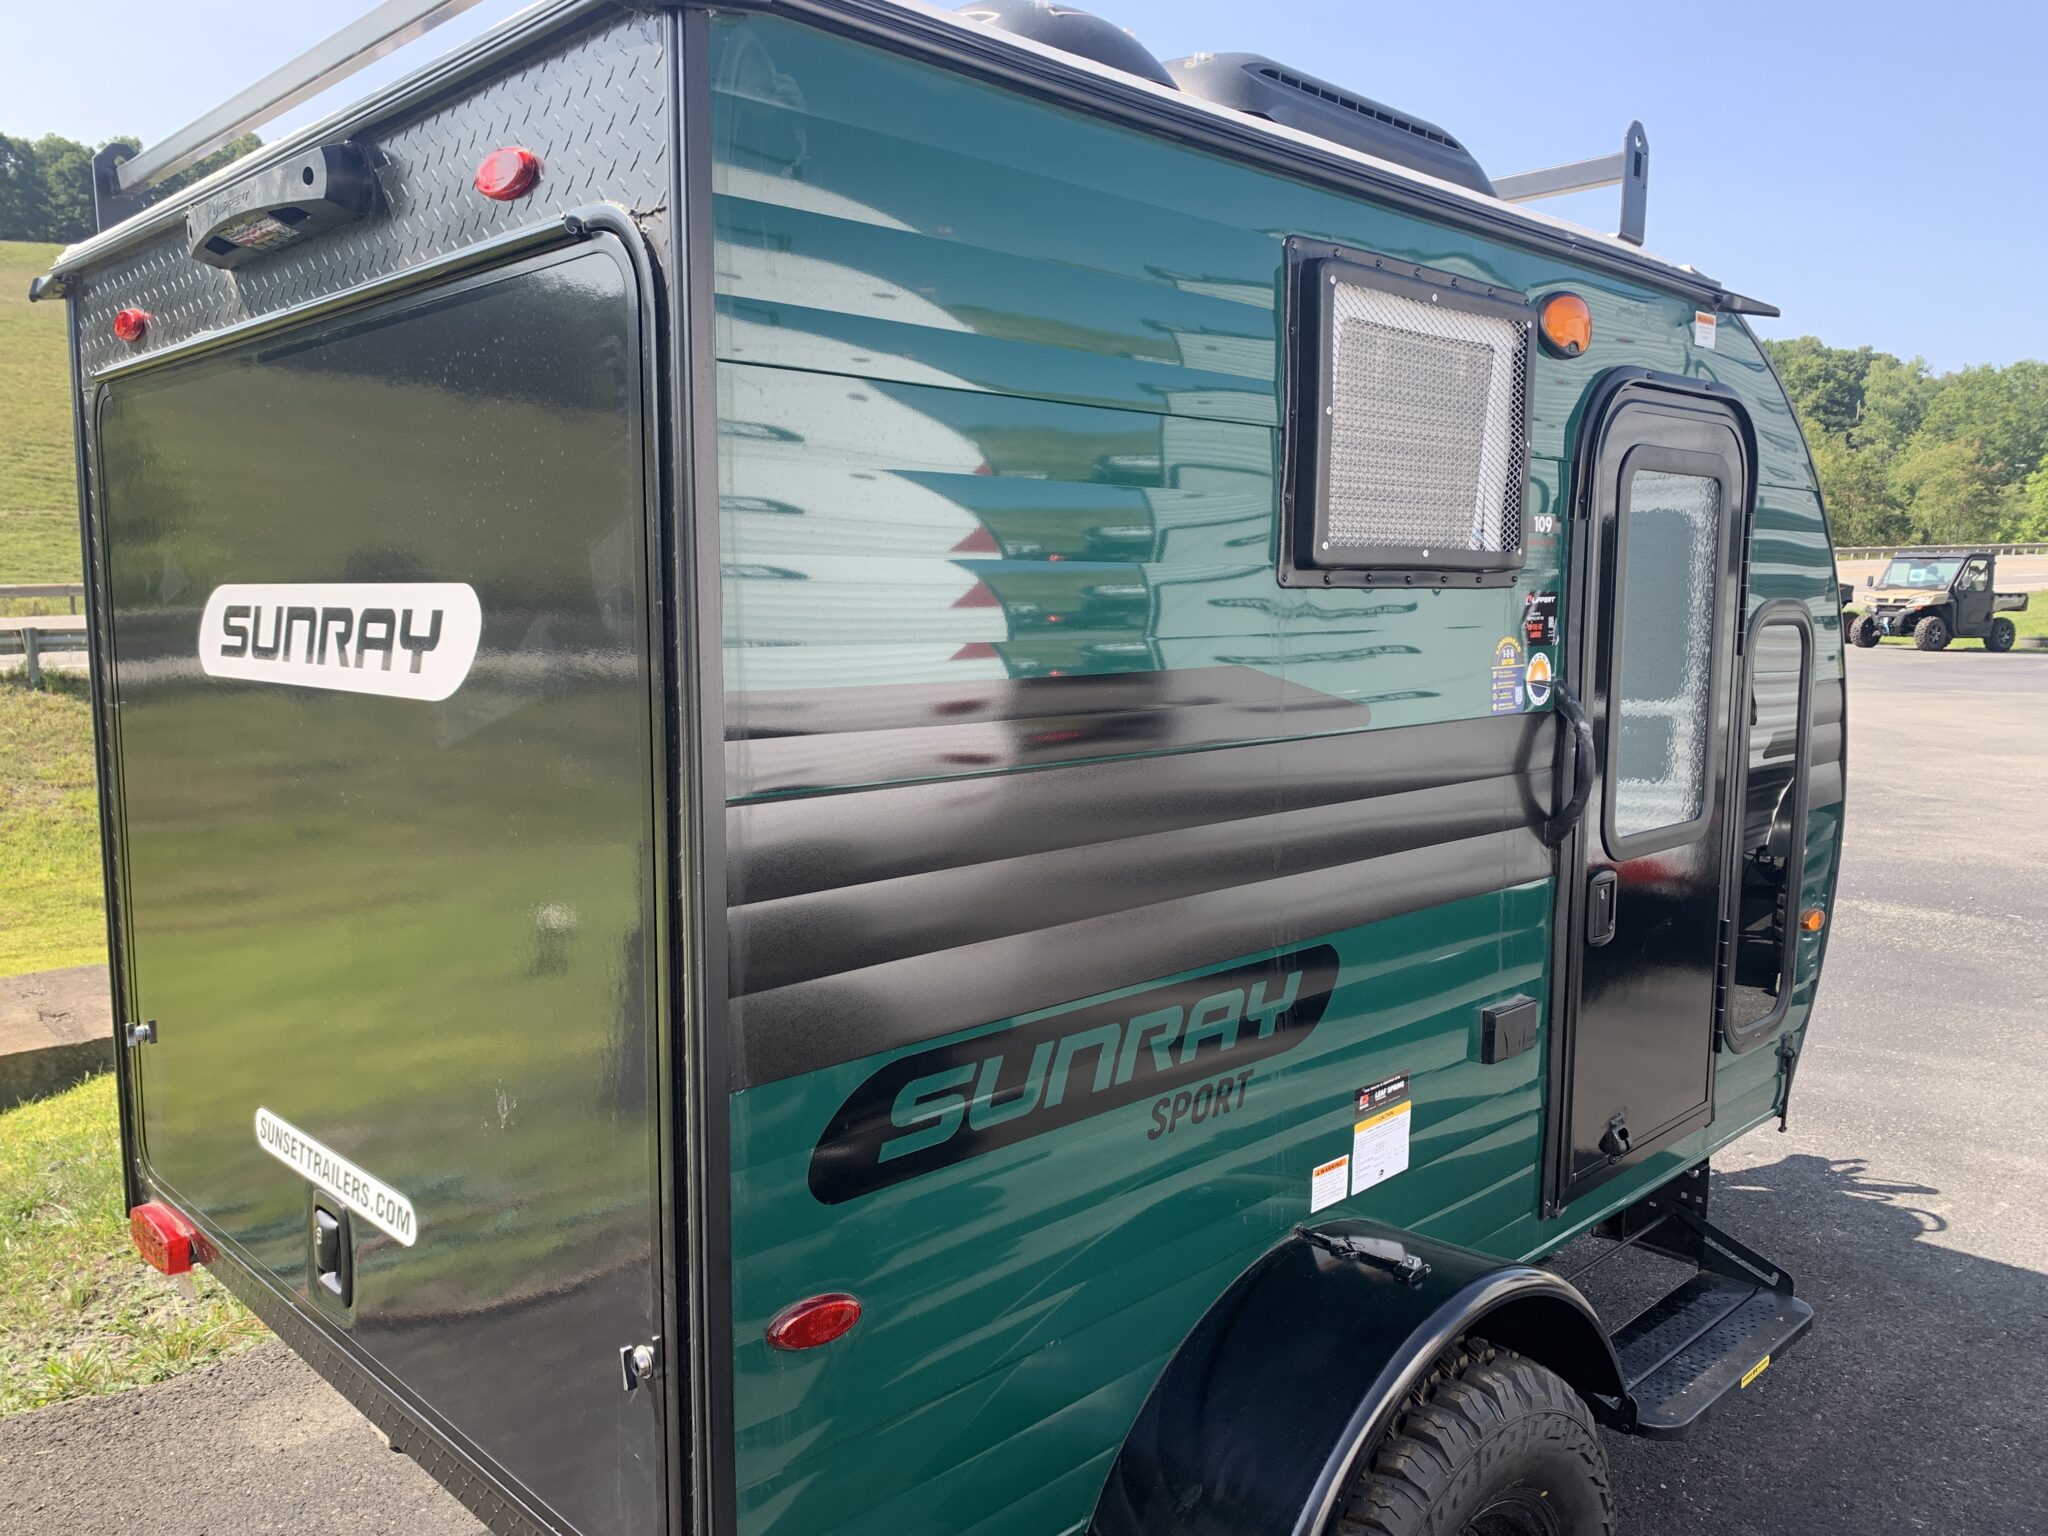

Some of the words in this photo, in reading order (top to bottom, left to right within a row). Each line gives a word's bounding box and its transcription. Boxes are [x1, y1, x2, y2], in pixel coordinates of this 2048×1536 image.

[1533, 515, 1553, 533] 109
[1531, 596, 1556, 604] LIPPERT
[220, 604, 444, 675] SUNRAY
[877, 969, 1304, 1165] SUNRAY
[1374, 1087, 1387, 1099] LEAF
[1146, 1069, 1256, 1142] SPORT
[258, 1113, 412, 1238] SUNSETTRAILERS.COM
